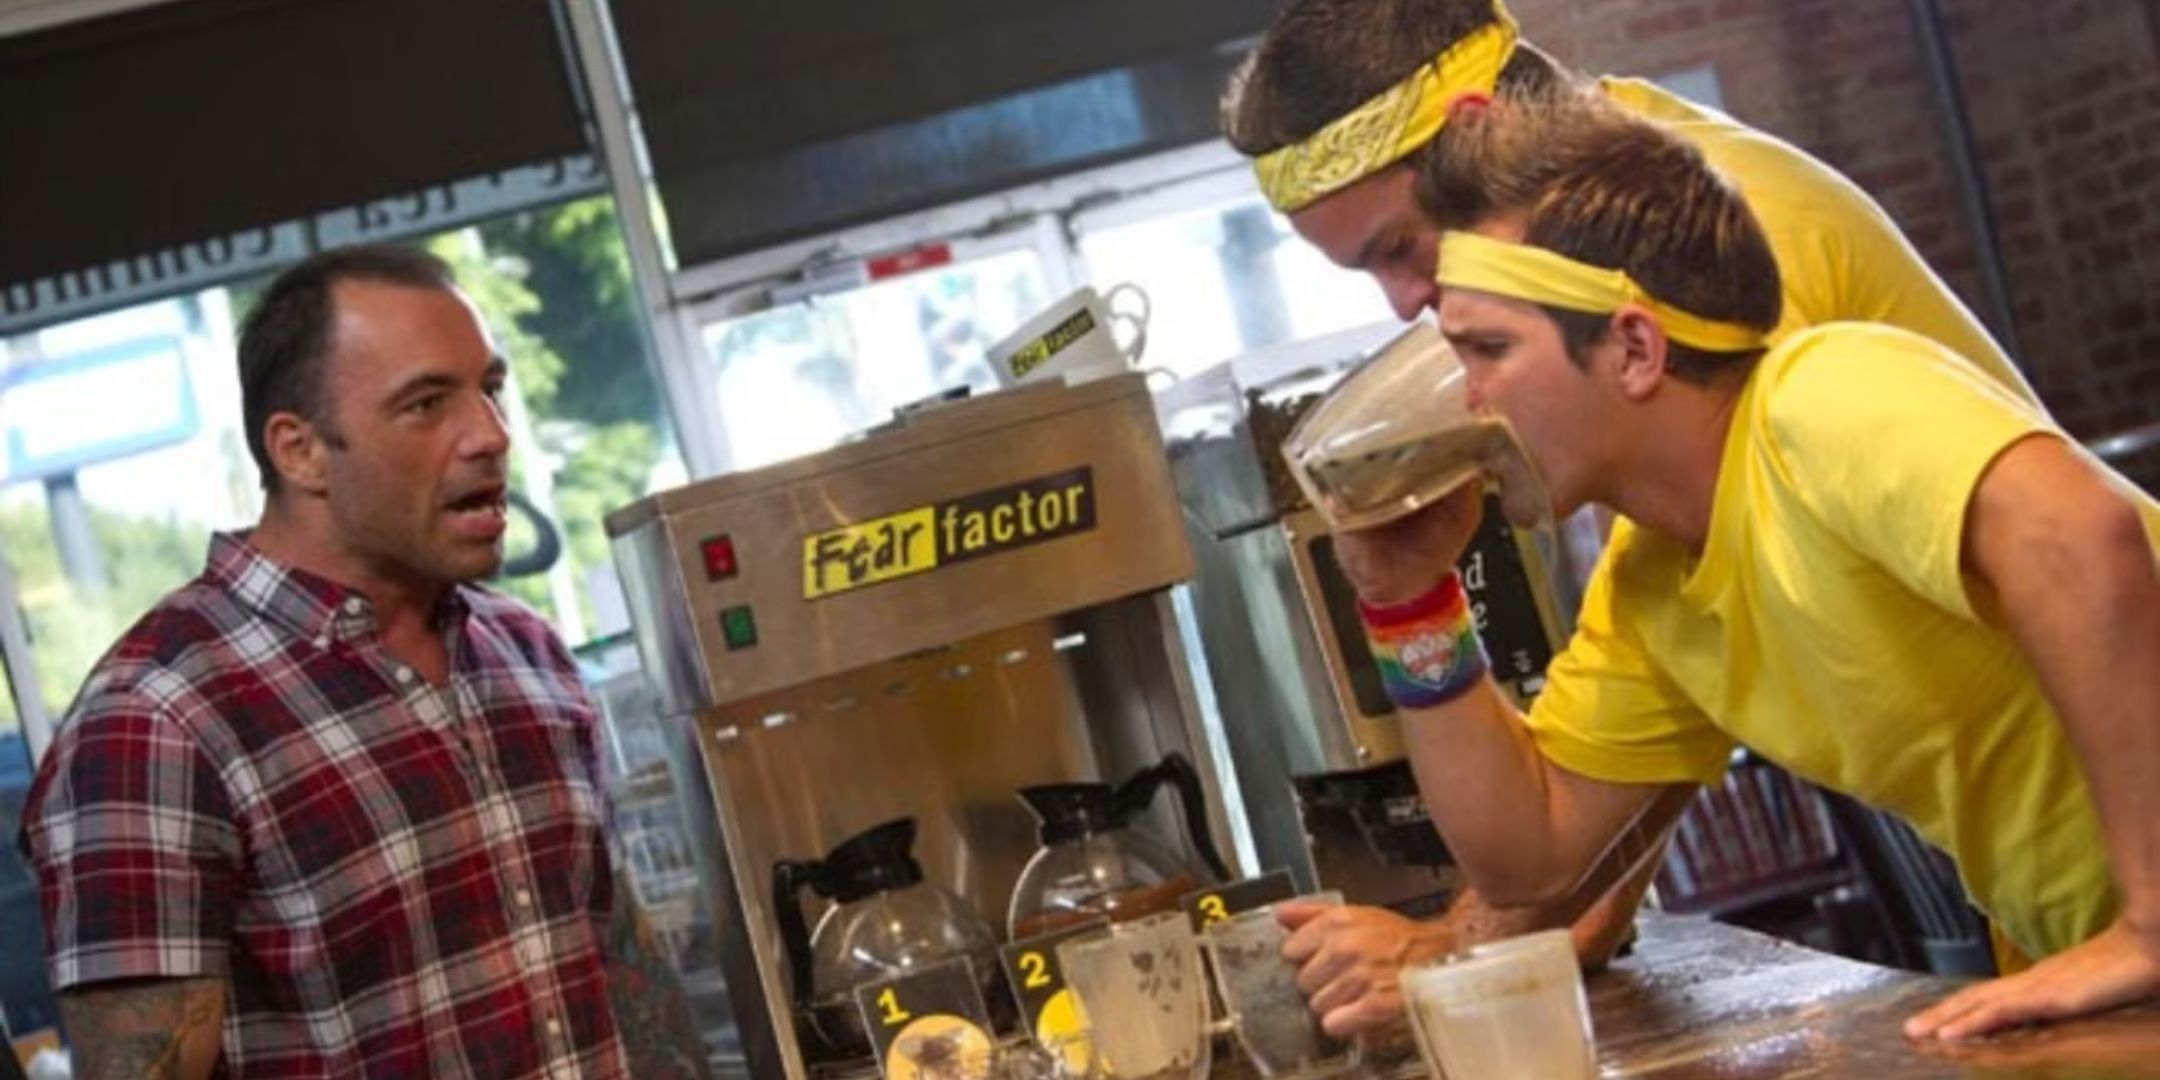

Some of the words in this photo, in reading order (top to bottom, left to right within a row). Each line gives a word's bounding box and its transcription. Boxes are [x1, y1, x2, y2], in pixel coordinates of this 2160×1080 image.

[810, 520, 924, 589] Fear
[942, 483, 1085, 555] factor
[1199, 894, 1229, 928] 3
[1019, 952, 1051, 988] 2
[876, 988, 910, 1025] 1
